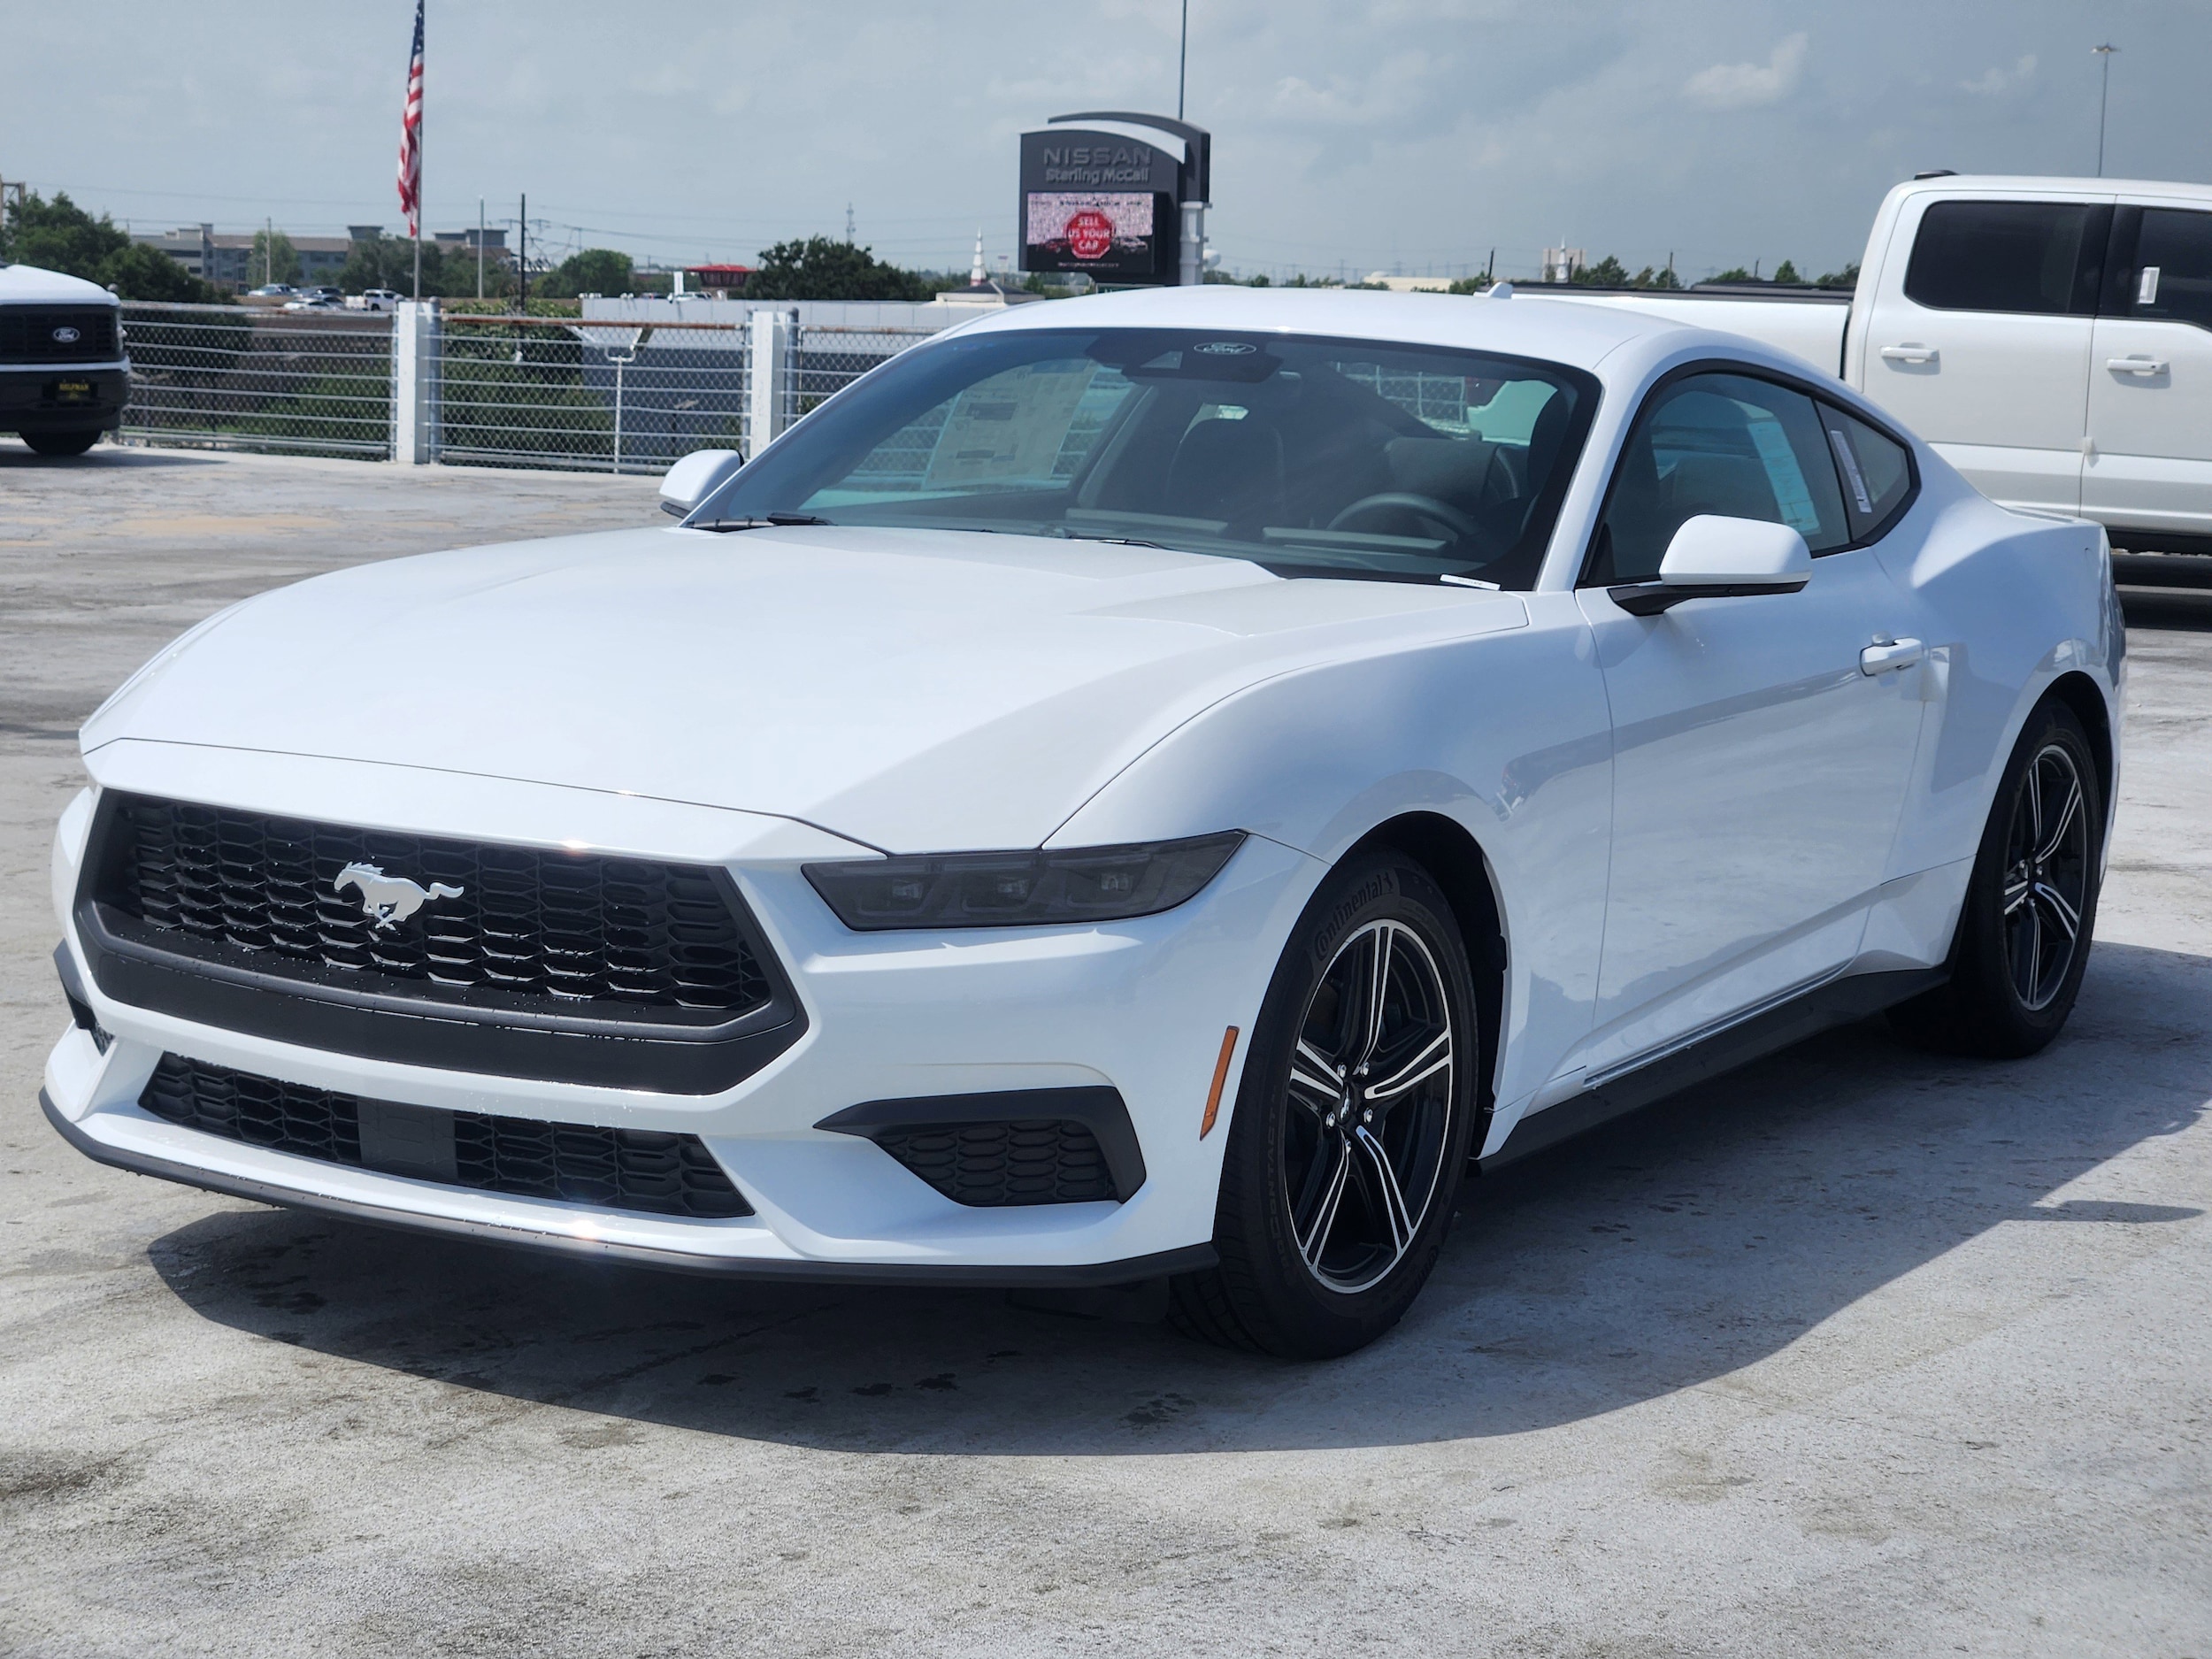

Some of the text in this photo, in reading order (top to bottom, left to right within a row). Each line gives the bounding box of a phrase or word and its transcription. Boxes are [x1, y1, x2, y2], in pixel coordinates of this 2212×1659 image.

[1044, 147, 1152, 165] NISSAN
[1046, 166, 1149, 185] Sterling McCall
[1079, 216, 1099, 227] SELL
[1068, 228, 1110, 238] US YOUR
[1078, 240, 1098, 250] CAR
[1314, 873, 1383, 962] Continental
